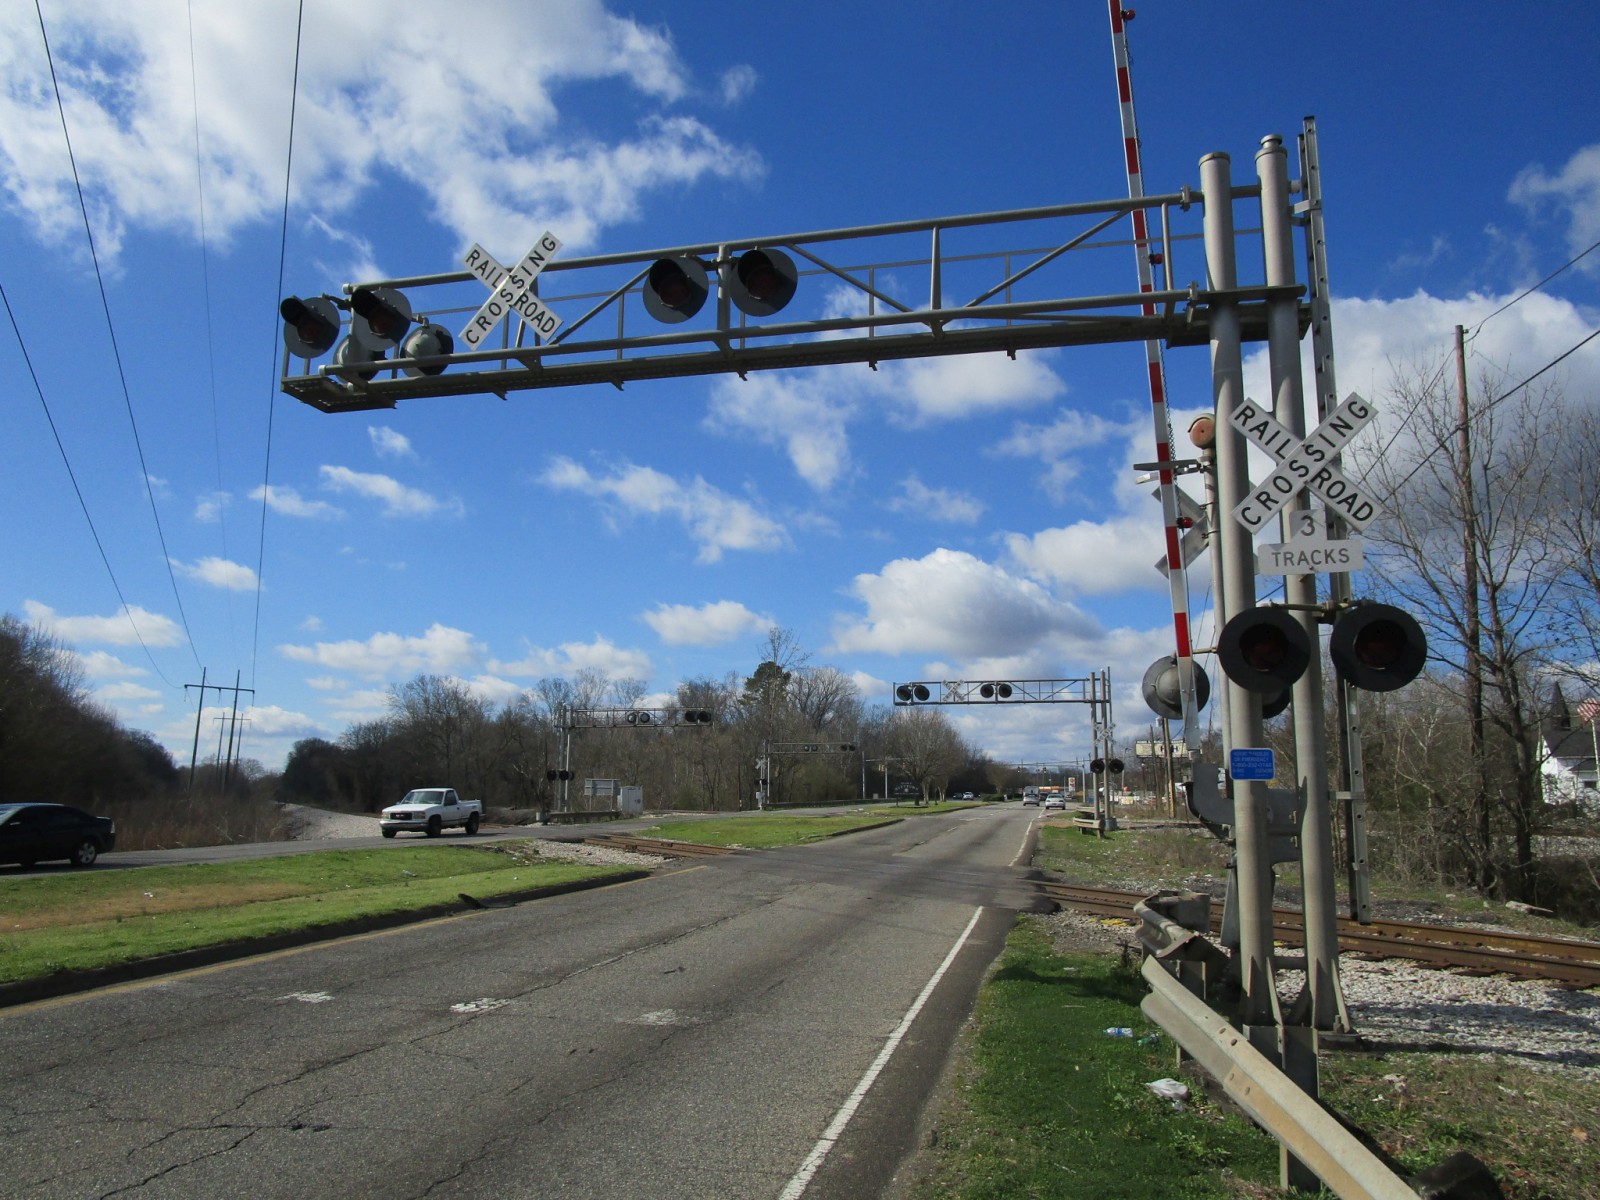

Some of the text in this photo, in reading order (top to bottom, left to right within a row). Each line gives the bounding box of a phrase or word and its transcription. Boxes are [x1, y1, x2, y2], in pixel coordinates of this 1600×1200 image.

[465, 237, 556, 344] CROSSING
[465, 249, 555, 333] RAIL ROAD
[1234, 404, 1373, 521] RAIL ROAD
[1240, 400, 1369, 526] CROSSING
[1271, 547, 1350, 567] TRACKS
[1300, 515, 1316, 537] 3
